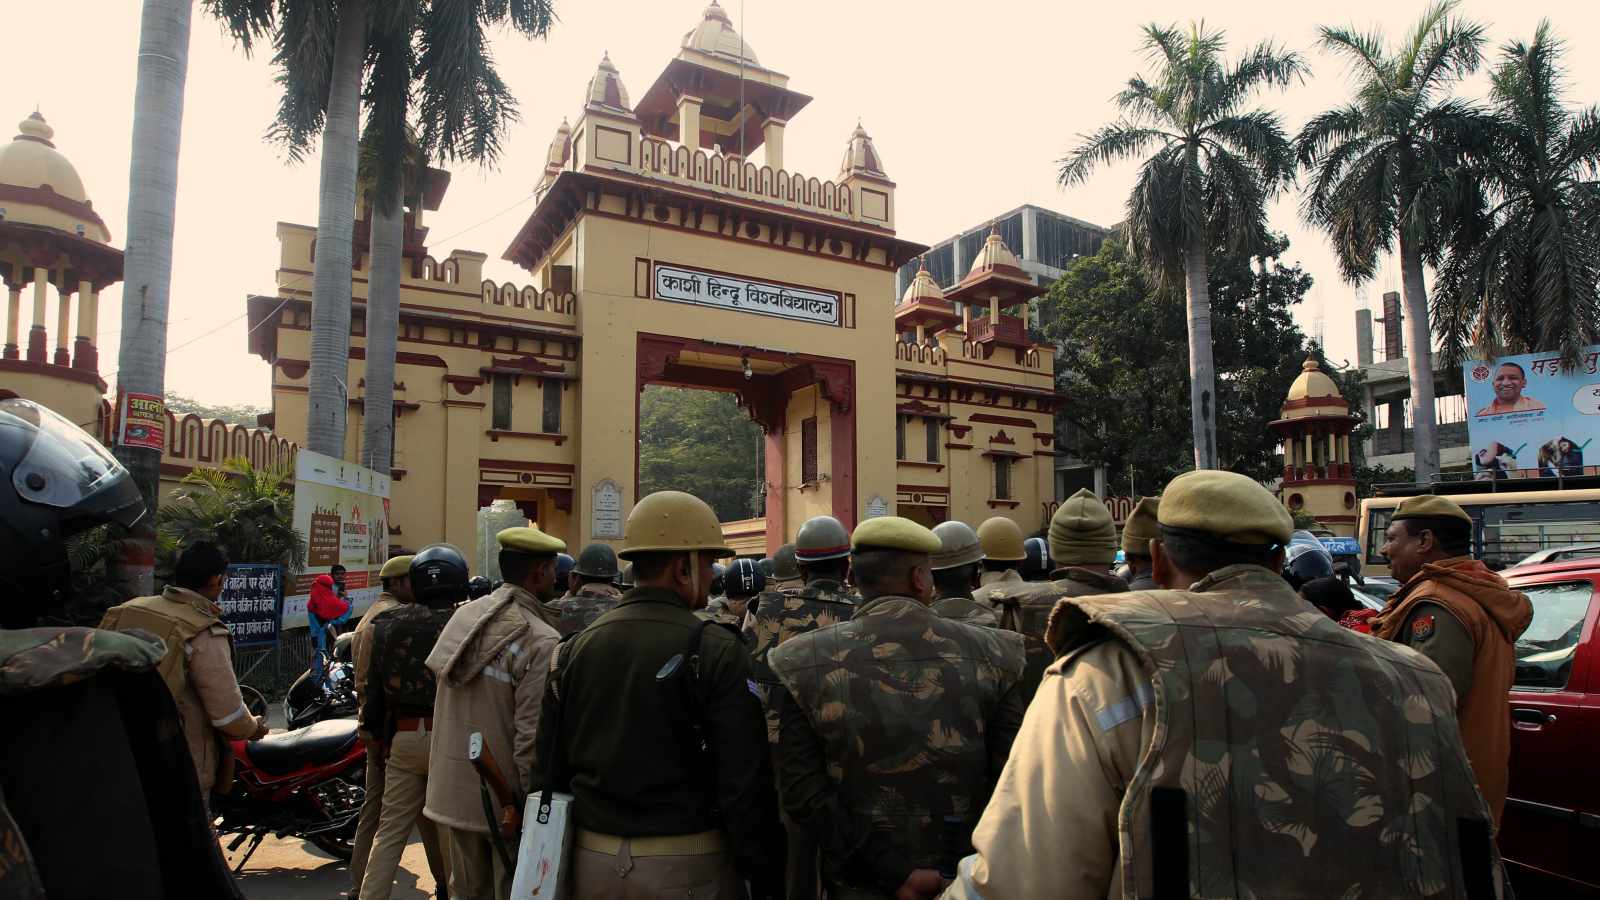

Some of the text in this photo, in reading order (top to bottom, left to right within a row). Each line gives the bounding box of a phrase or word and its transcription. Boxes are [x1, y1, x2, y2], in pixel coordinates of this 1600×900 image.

[662, 274, 833, 315] काशी हिन्दू विश्वविद्यालय
